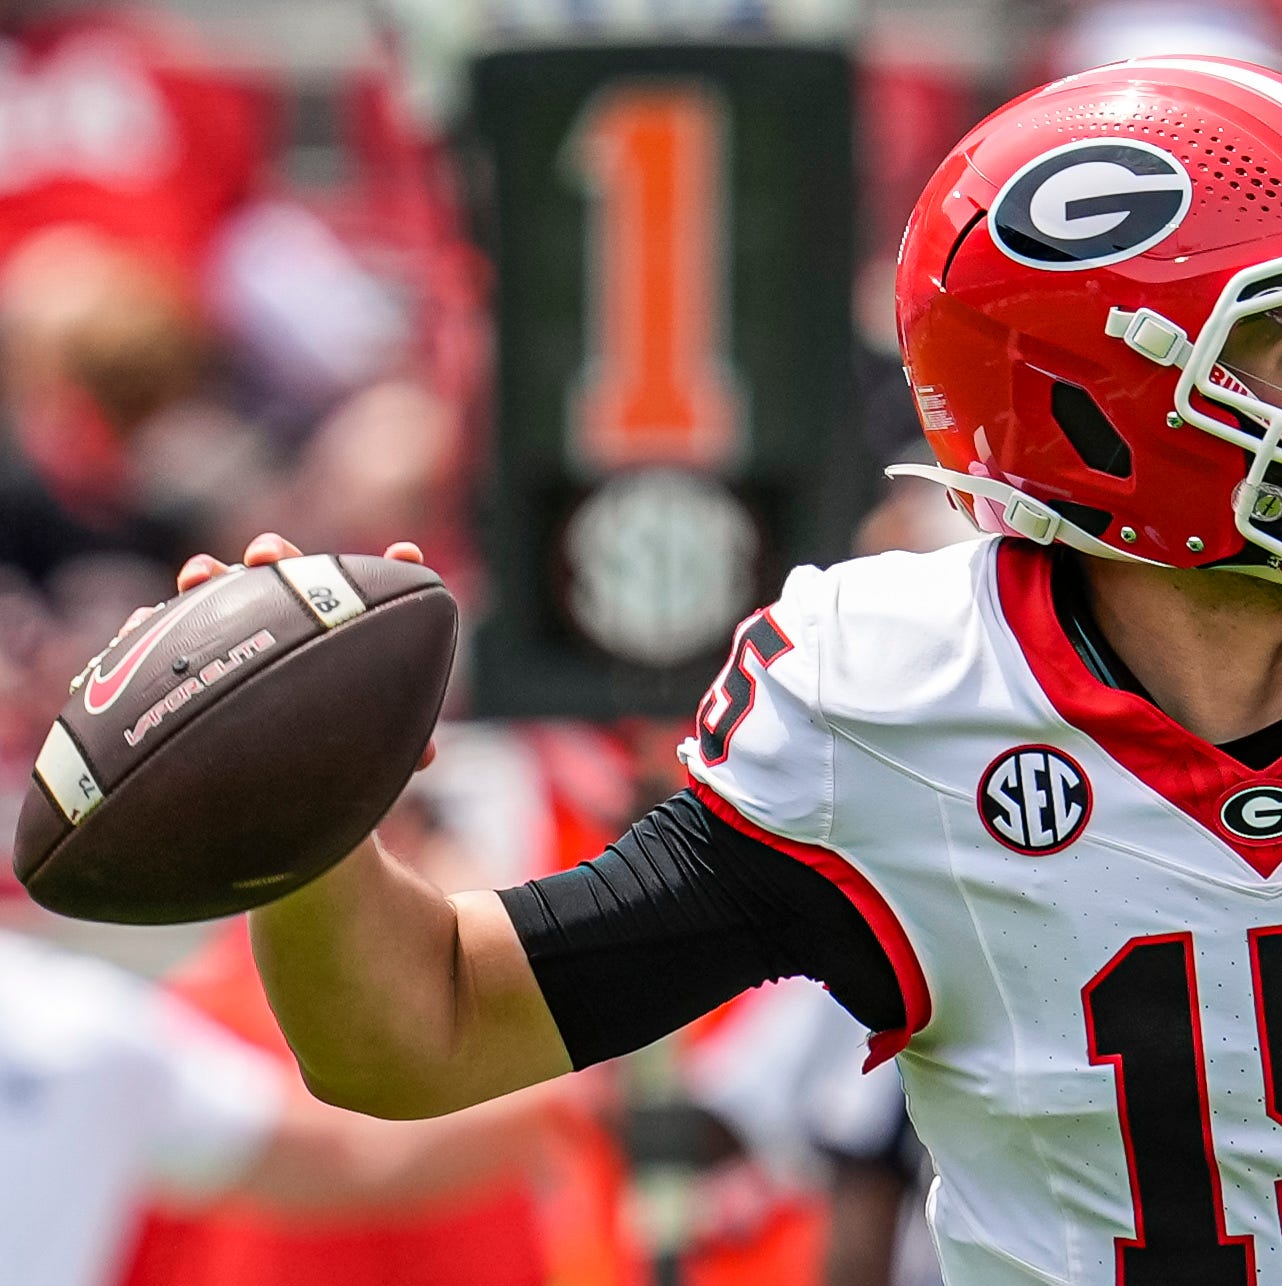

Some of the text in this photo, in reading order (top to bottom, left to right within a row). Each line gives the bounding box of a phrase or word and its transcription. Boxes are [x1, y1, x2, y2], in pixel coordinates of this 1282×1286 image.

[994, 143, 1186, 263] G
[563, 80, 748, 466] 1
[124, 629, 276, 746] VAPOR ELITE
[986, 752, 1083, 848] SEC
